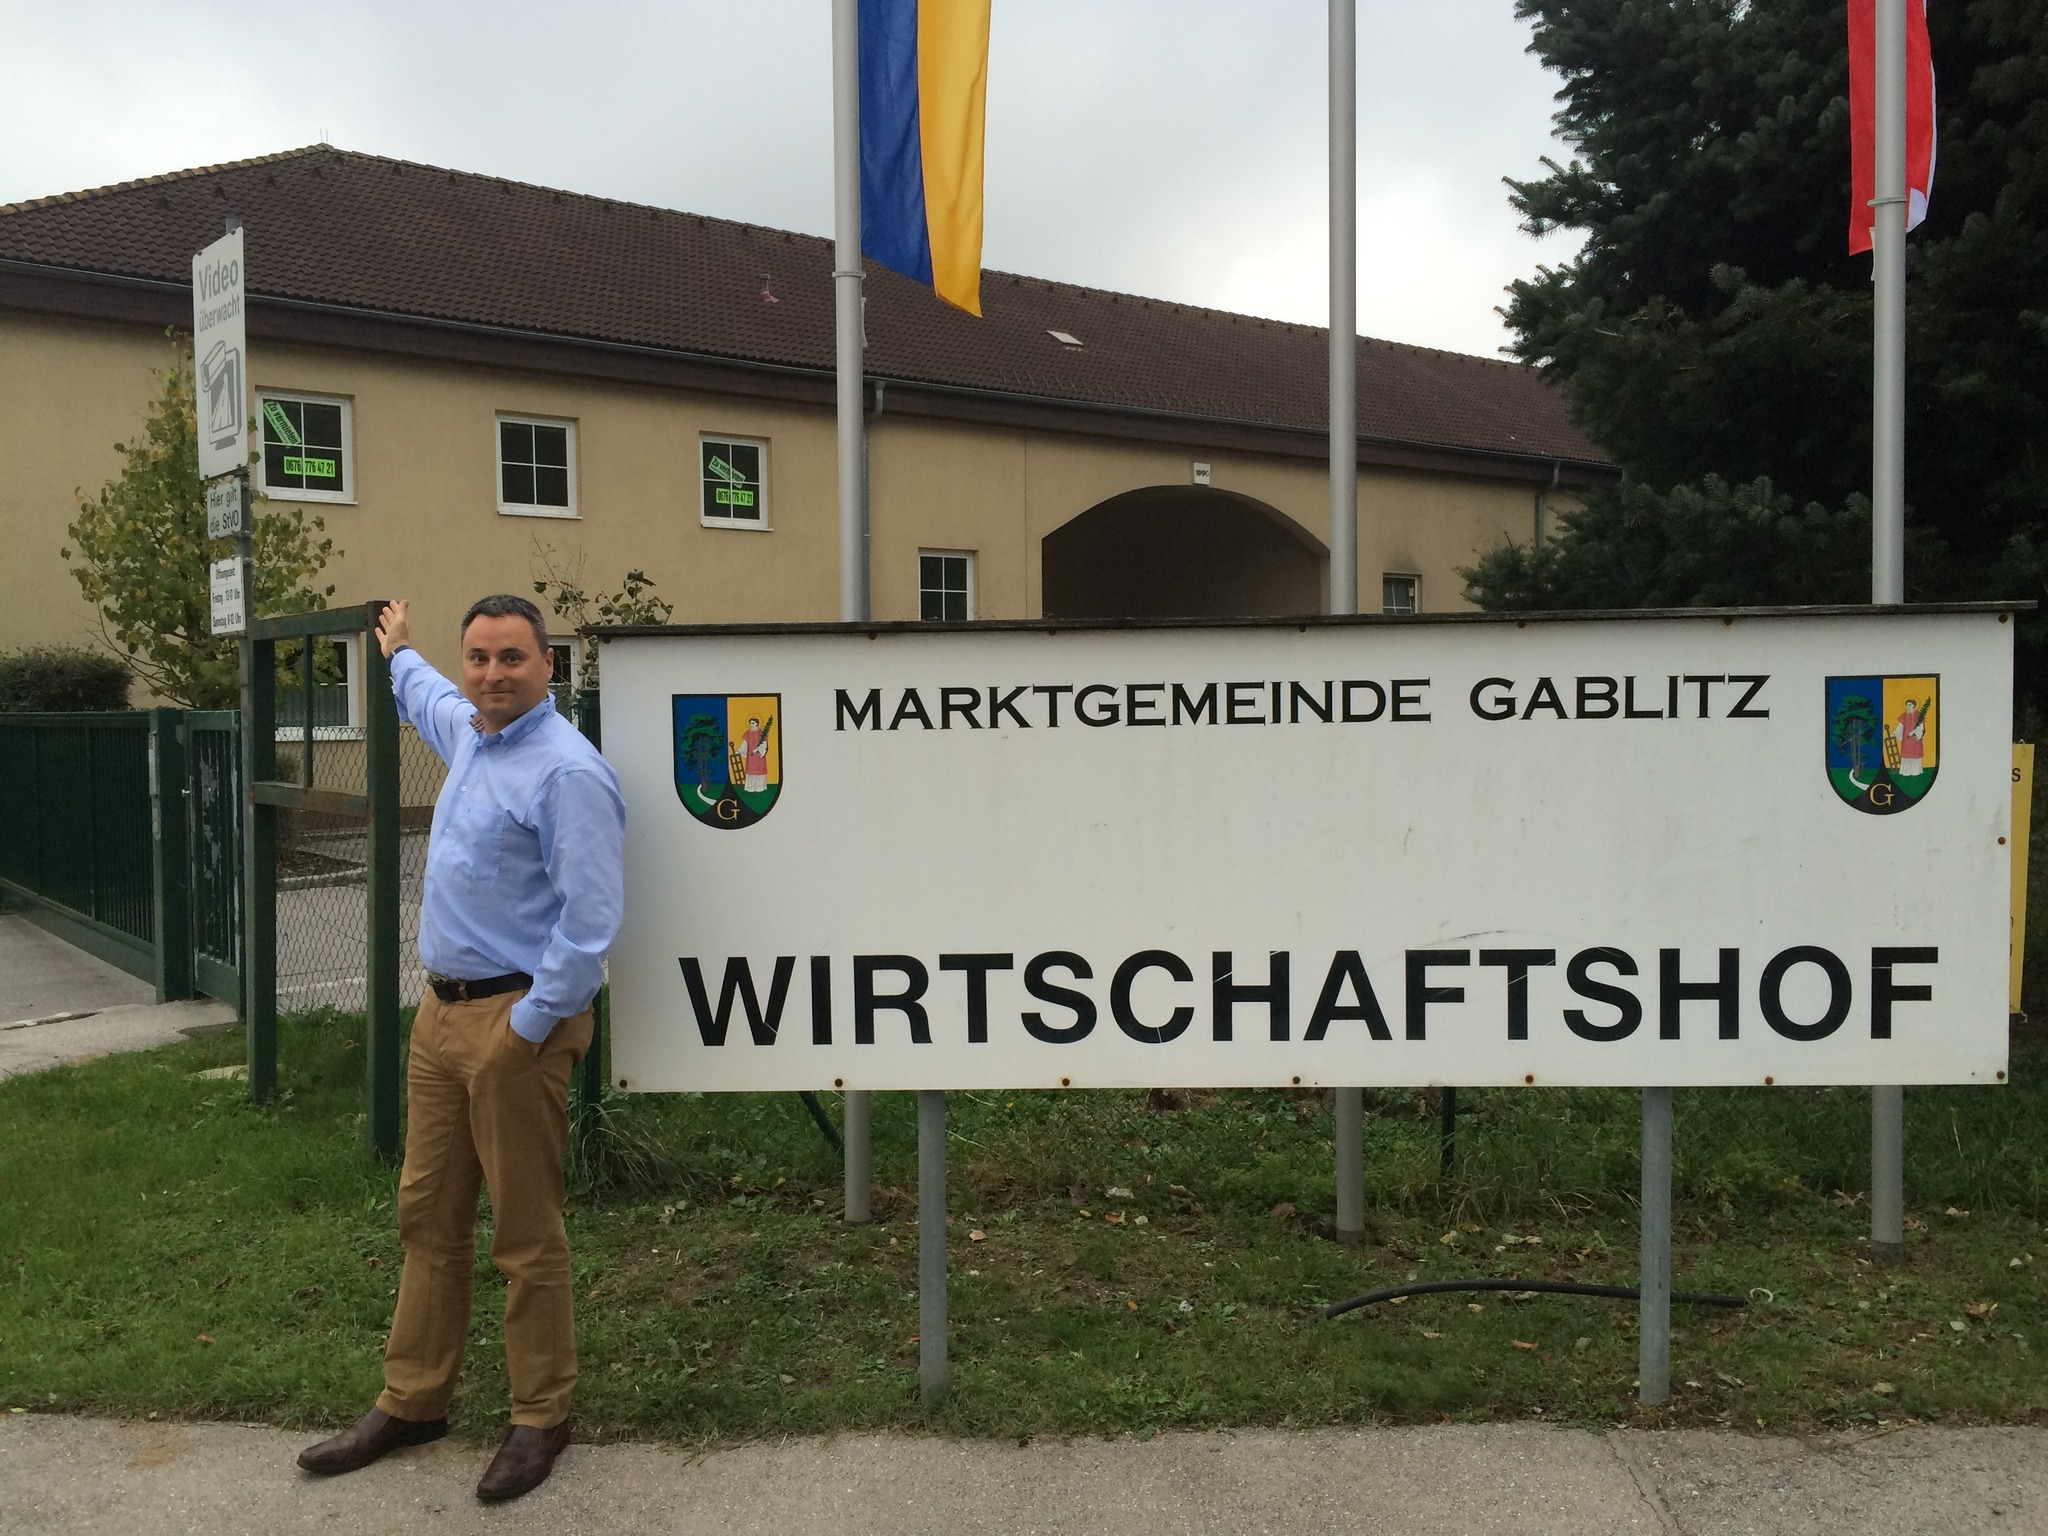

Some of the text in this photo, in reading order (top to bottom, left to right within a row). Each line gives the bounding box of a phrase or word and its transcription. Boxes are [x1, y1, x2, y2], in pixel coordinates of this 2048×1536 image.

[199, 259, 239, 302] Video
[199, 293, 240, 332] überwacht
[267, 401, 278, 413] Zu
[273, 411, 298, 445] vermieten
[304, 460, 316, 473] 776
[317, 462, 325, 474] 47
[326, 462, 334, 475] 21
[210, 488, 237, 509] Hier gilt
[210, 509, 239, 533] die StVO
[212, 592, 223, 605] Freitag
[212, 614, 226, 630] Samstag
[834, 674, 1771, 731] MARKTGEMEINDE GABLITZ
[1869, 783, 1894, 806] G
[716, 798, 740, 821] G
[678, 946, 1939, 1047] WIRTSCHAFTSHOF
